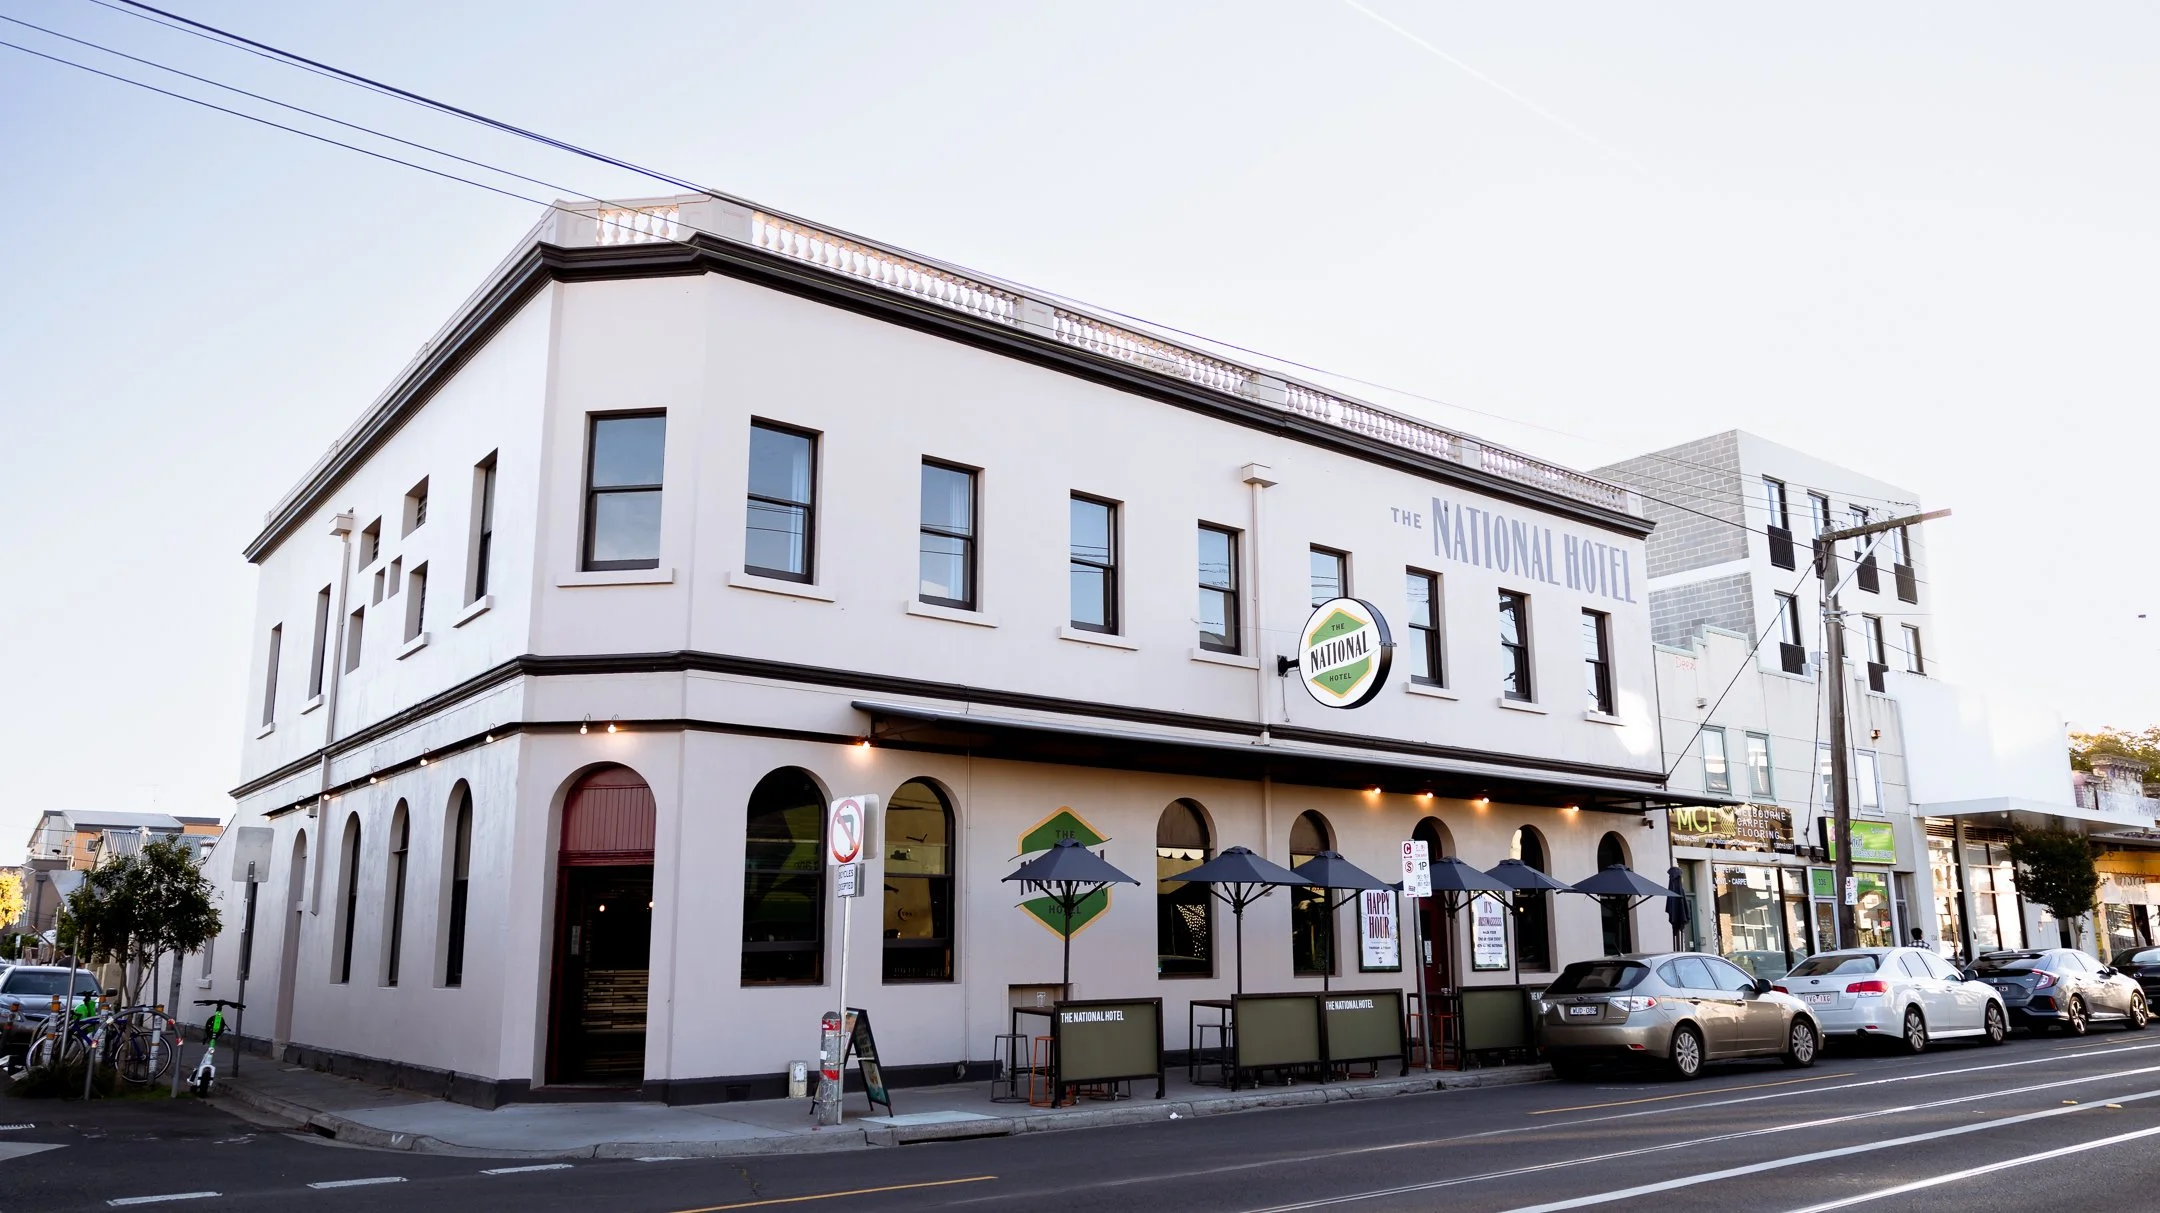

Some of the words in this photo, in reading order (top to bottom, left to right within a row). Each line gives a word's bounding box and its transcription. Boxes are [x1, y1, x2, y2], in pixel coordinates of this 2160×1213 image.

[1390, 506, 1422, 529] THE
[1431, 496, 1561, 586] NATIONAL
[1563, 533, 1637, 605] HOTEL
[1331, 623, 1345, 632] THE
[1310, 630, 1370, 673] NATIONAL
[1329, 672, 1352, 682] HOTEL
[1676, 807, 1718, 833] MCF
[1735, 807, 1786, 821] MELBOURNE
[1736, 817, 1769, 829] CARPET
[1055, 829, 1076, 839] THE
[1737, 828, 1781, 840] FLOORING
[1366, 892, 1390, 915] HAPPY
[1368, 916, 1390, 939] HOUR
[1325, 1001, 1335, 1010] THE
[1335, 1000, 1359, 1010] NATIONAL
[1358, 999, 1374, 1009] HOTEL
[1060, 1012, 1073, 1024] THE
[1073, 1010, 1105, 1023] NATIONAL
[1105, 1010, 1125, 1021] HOTEL
